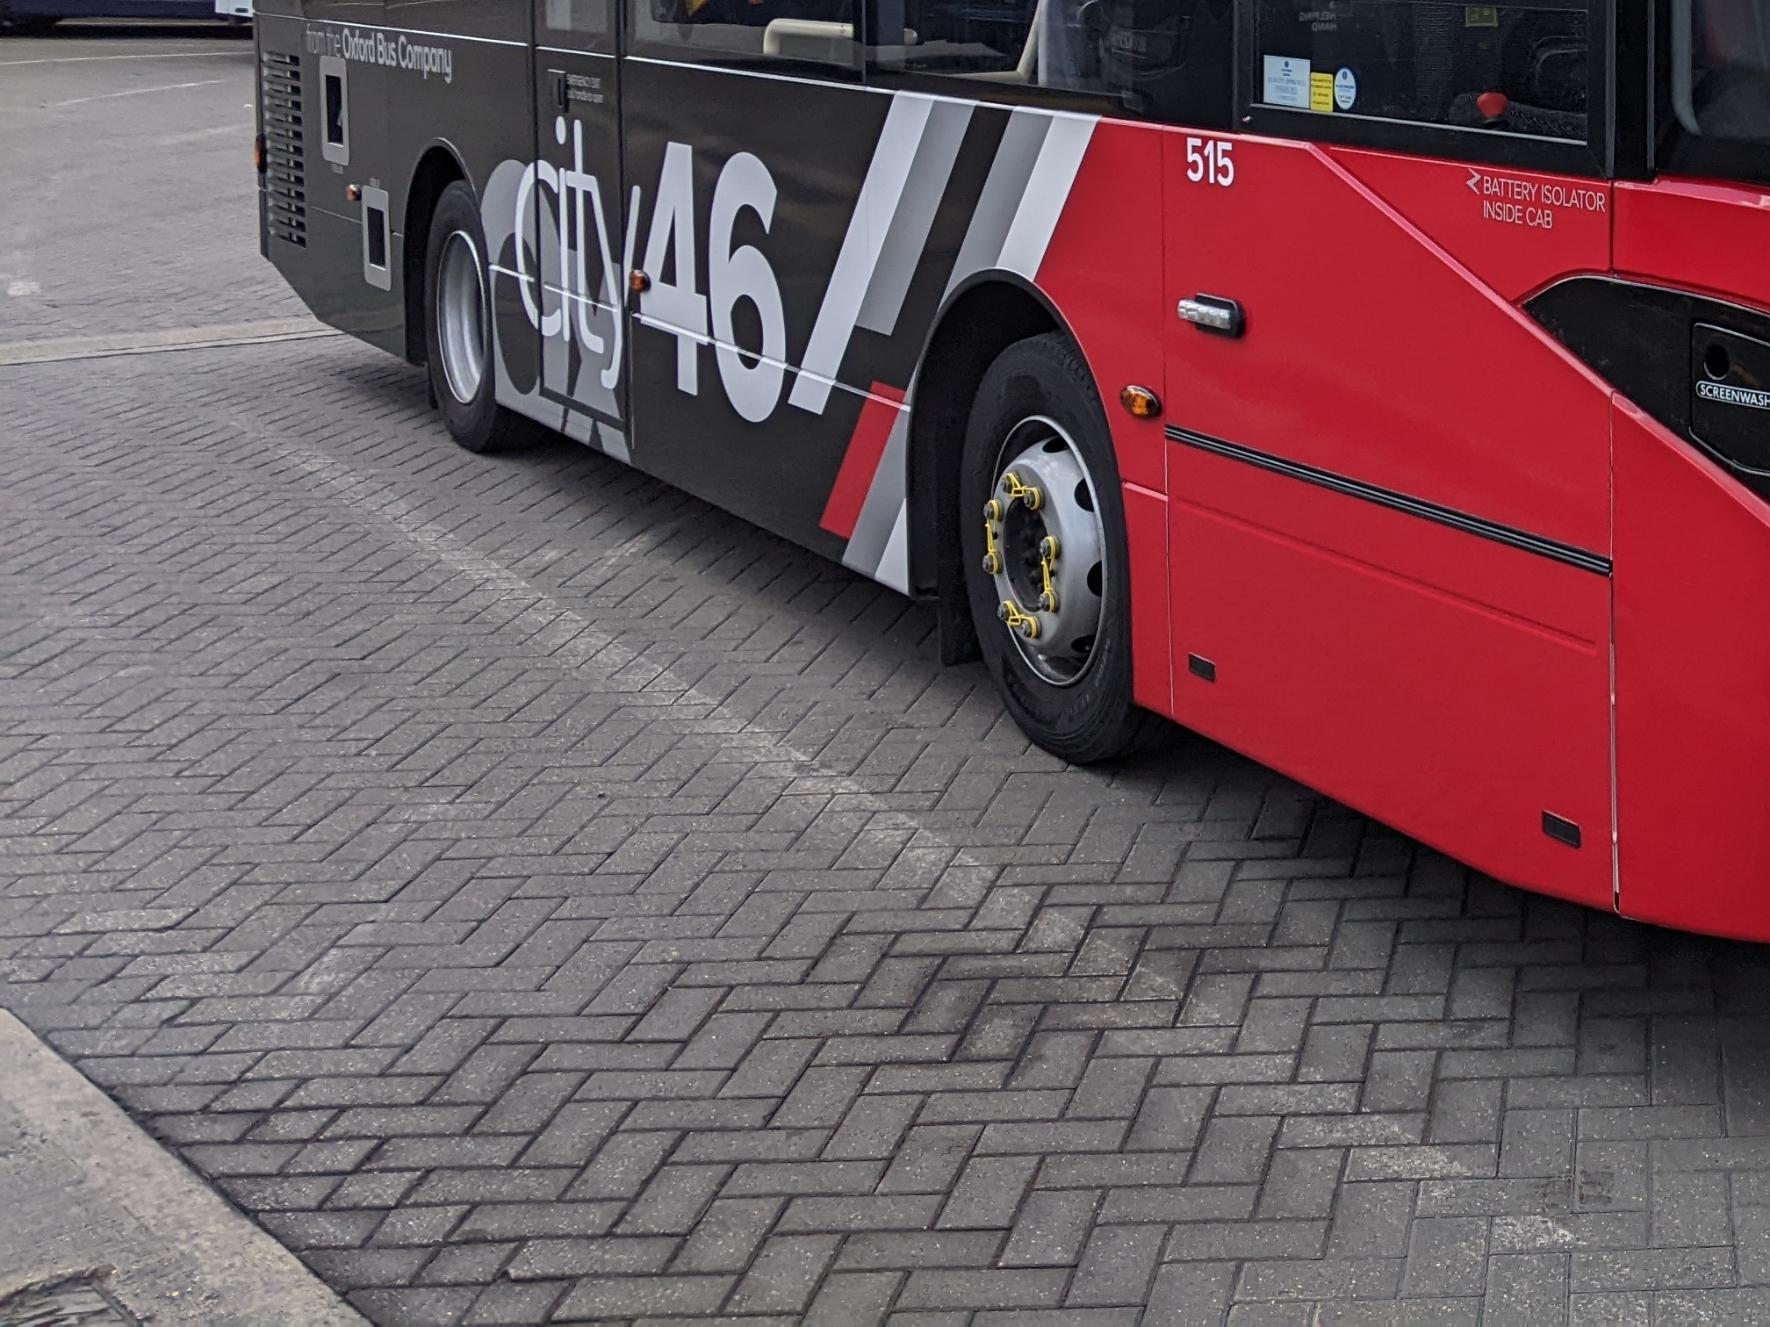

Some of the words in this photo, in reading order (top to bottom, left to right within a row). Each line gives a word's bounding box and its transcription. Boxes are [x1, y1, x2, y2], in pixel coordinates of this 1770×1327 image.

[342, 28, 375, 63] Oxford
[376, 32, 397, 66] Bus
[398, 34, 452, 84] Company
[1186, 137, 1235, 187] 515
[1483, 175, 1538, 202] BATTERY
[1541, 183, 1606, 212] ISOLATOR
[1483, 200, 1523, 224] INSIDE
[1525, 207, 1553, 229] CAB
